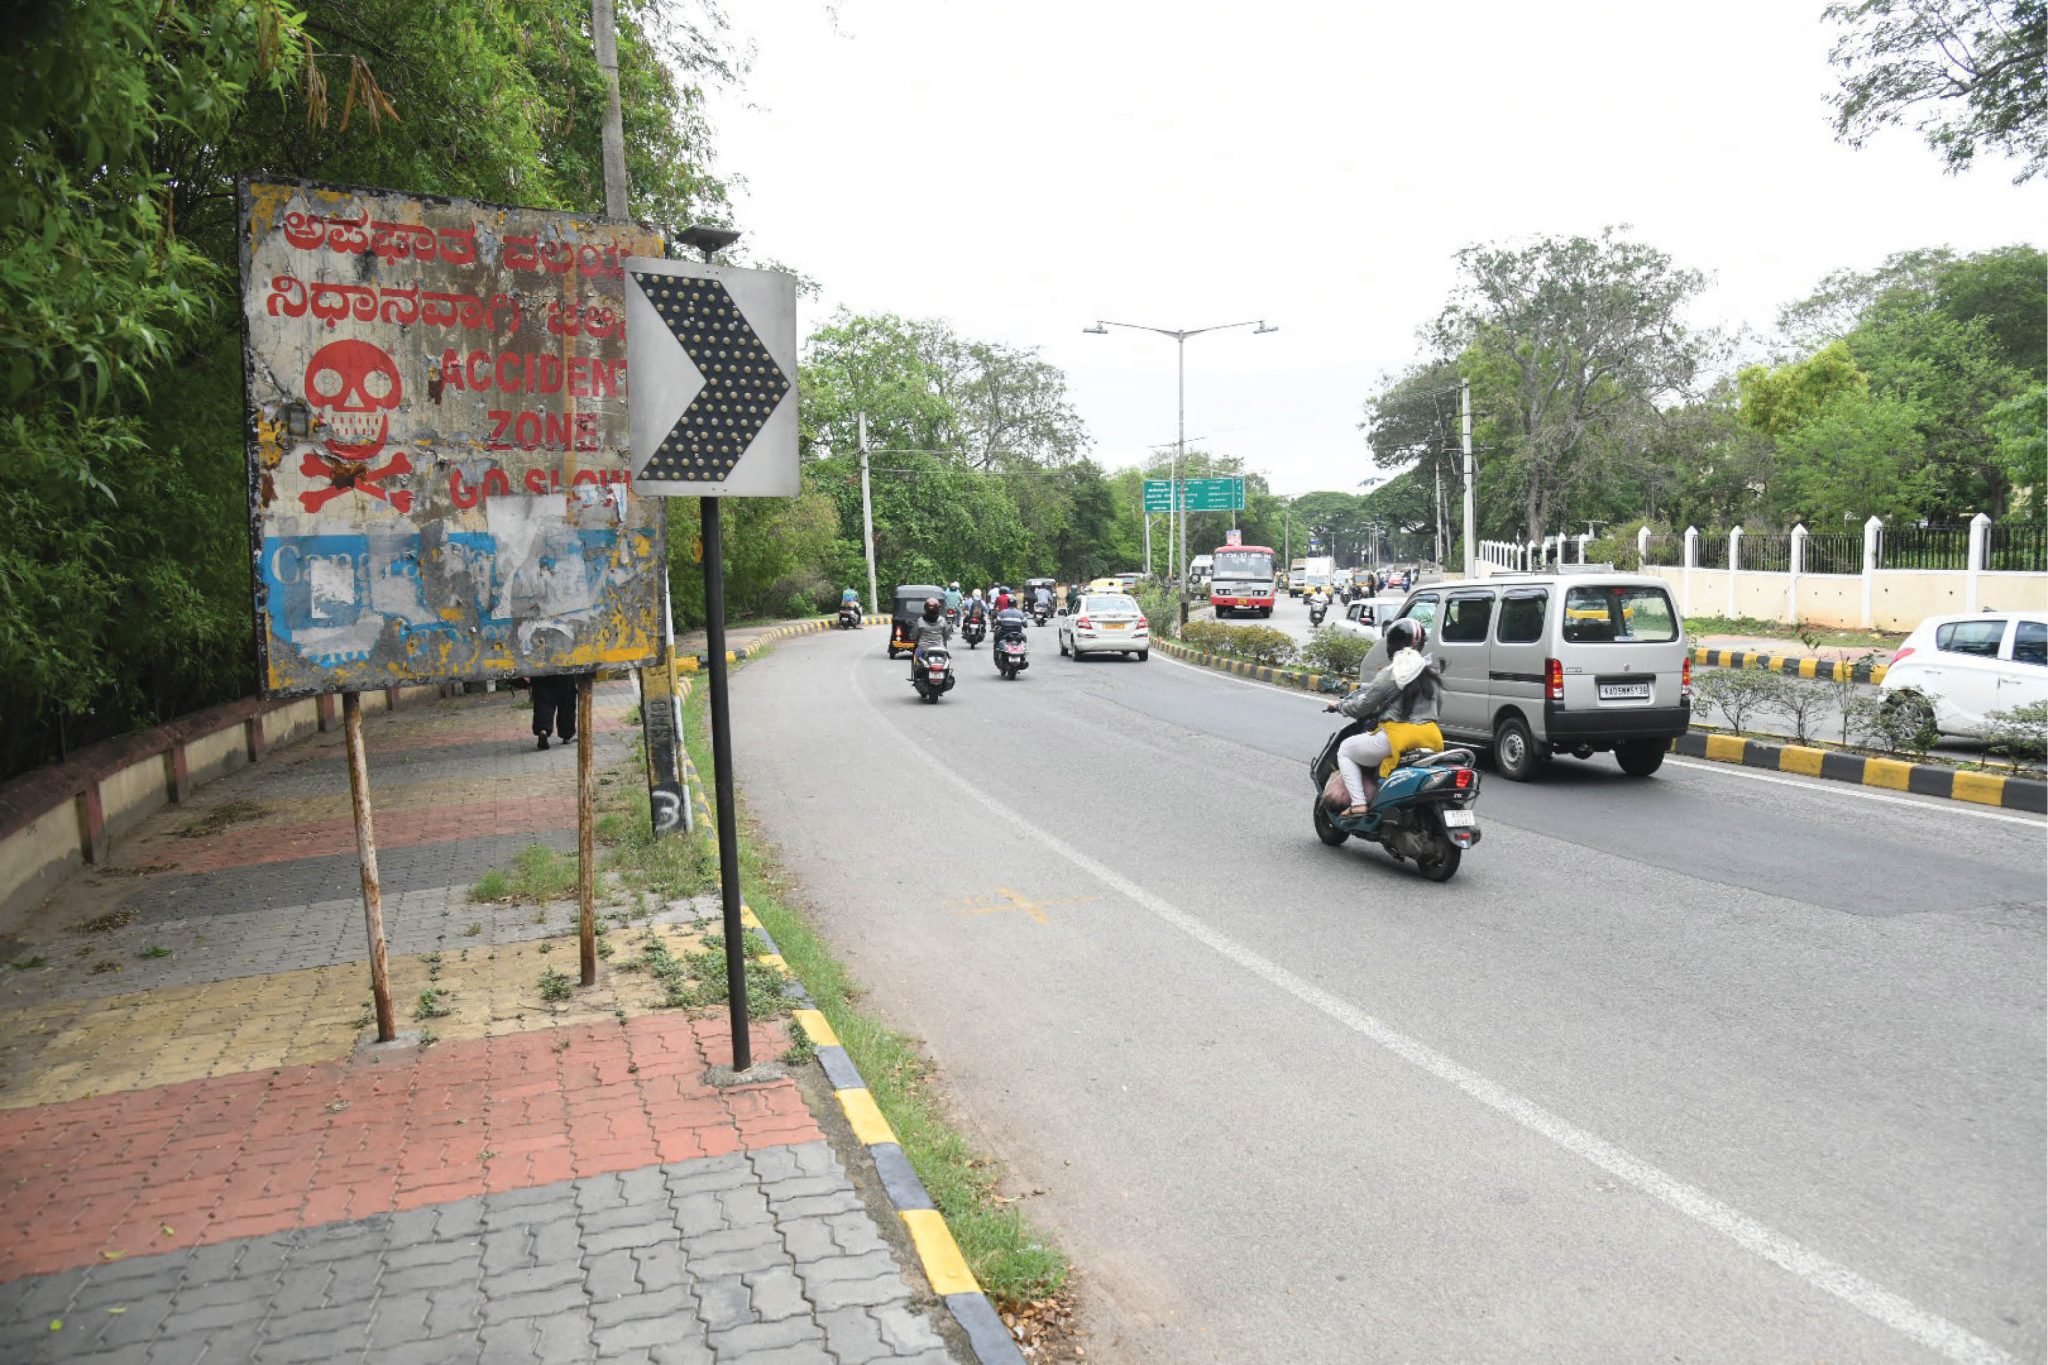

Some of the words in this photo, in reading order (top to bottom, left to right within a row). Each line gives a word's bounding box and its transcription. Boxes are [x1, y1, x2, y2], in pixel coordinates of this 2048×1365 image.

[284, 205, 476, 266] ಅಪಘಾತ
[486, 410, 597, 452] ZONE
[450, 467, 510, 510] GO
